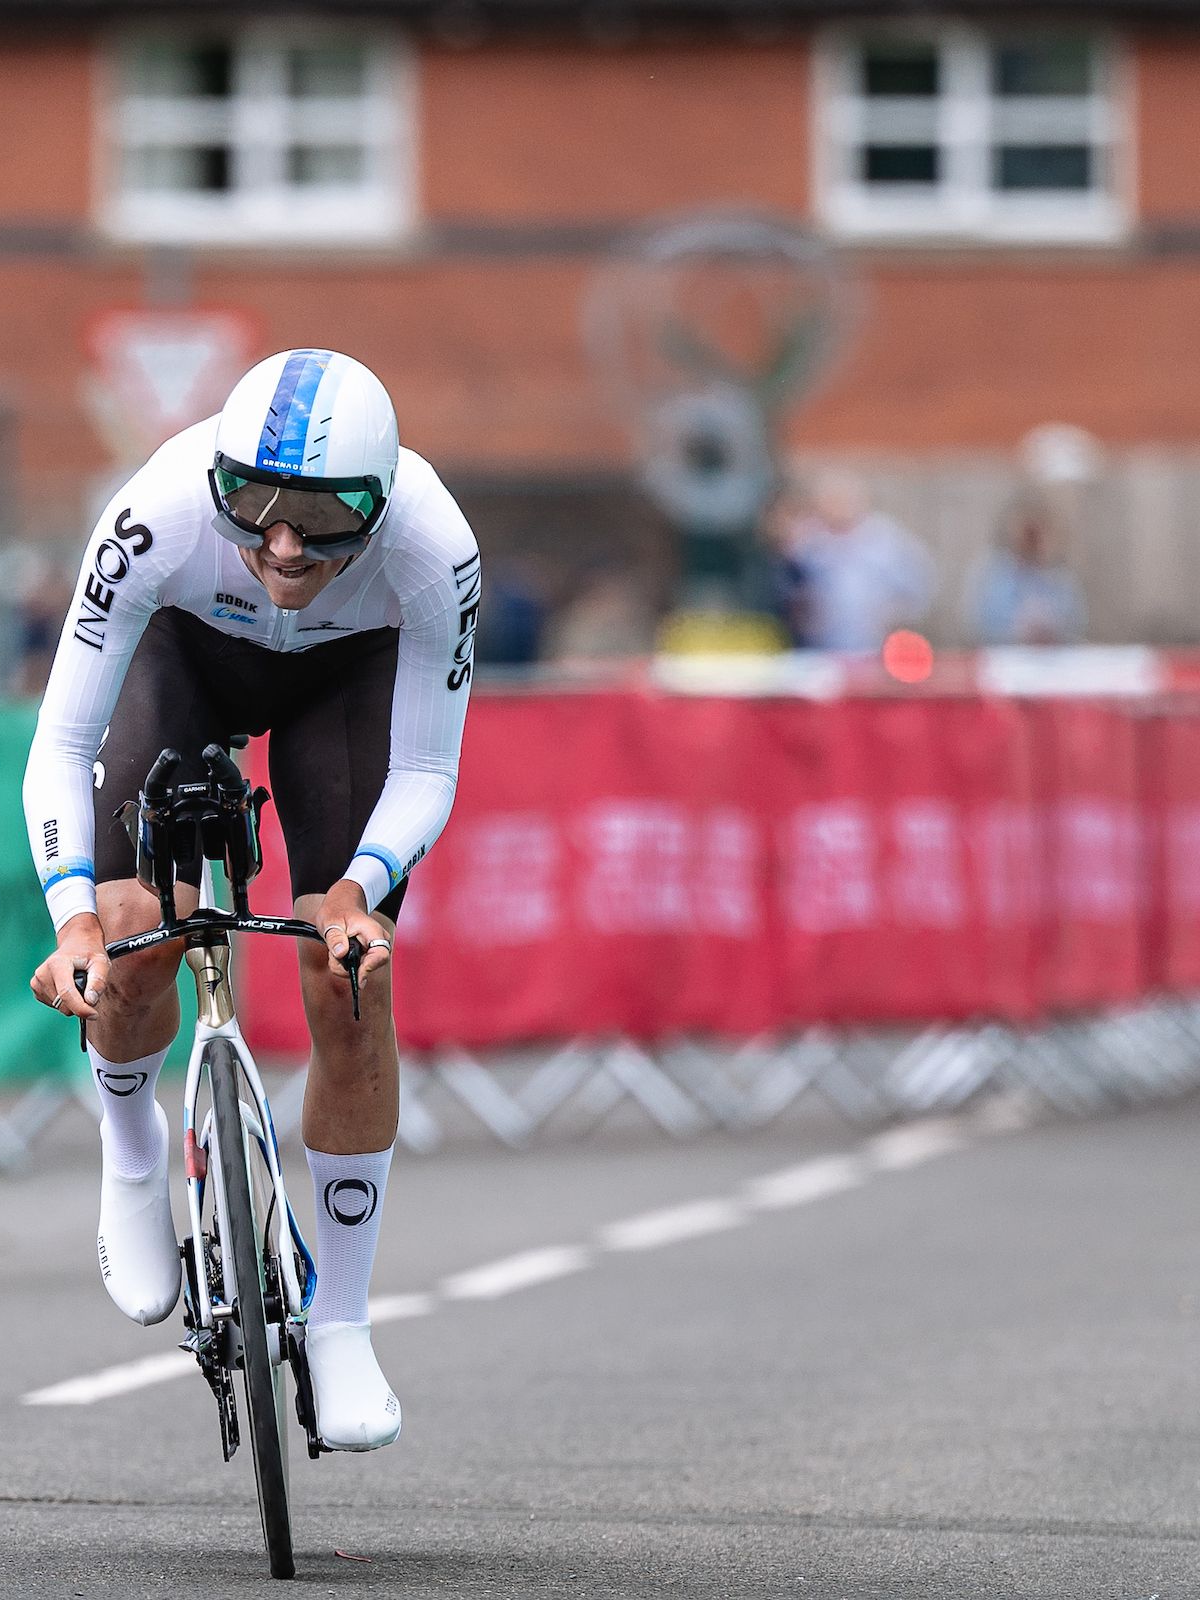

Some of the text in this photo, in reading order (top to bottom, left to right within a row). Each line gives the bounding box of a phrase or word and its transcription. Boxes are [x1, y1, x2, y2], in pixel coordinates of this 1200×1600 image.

[262, 458, 316, 473] GRENADIER
[73, 507, 153, 652] INEOS
[215, 593, 258, 613] GOBIK
[447, 552, 481, 691] INEOS
[183, 785, 207, 793] GARMIN
[43, 819, 59, 861] GOBIK
[238, 919, 286, 930] MOST
[128, 929, 170, 949] MOST
